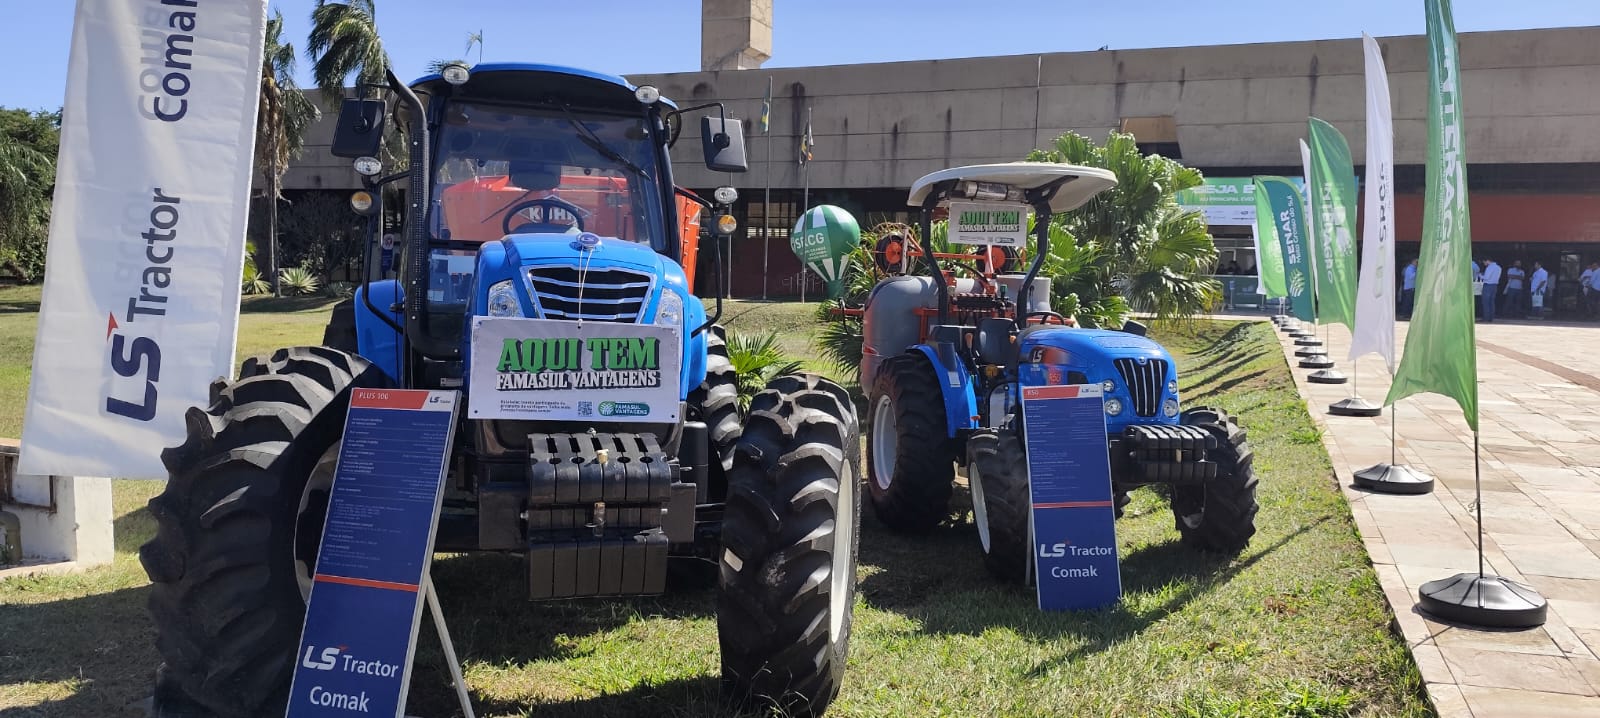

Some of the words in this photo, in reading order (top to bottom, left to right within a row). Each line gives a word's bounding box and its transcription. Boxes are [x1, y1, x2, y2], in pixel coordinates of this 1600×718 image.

[1280, 210, 1296, 264] SENAR
[127, 187, 181, 322] Tractor
[497, 338, 580, 373] AQUI
[587, 337, 658, 371] TEM
[1033, 351, 1043, 363] LS
[107, 333, 161, 421] LS
[496, 372, 568, 390] FAMASUL
[569, 371, 658, 389] VANTAGENS
[1040, 543, 1066, 557] LS
[1069, 546, 1113, 556] Tractor
[1051, 565, 1098, 578] Comak
[303, 646, 340, 670] LS
[343, 655, 399, 678] Tractor
[310, 686, 370, 713] Comak
